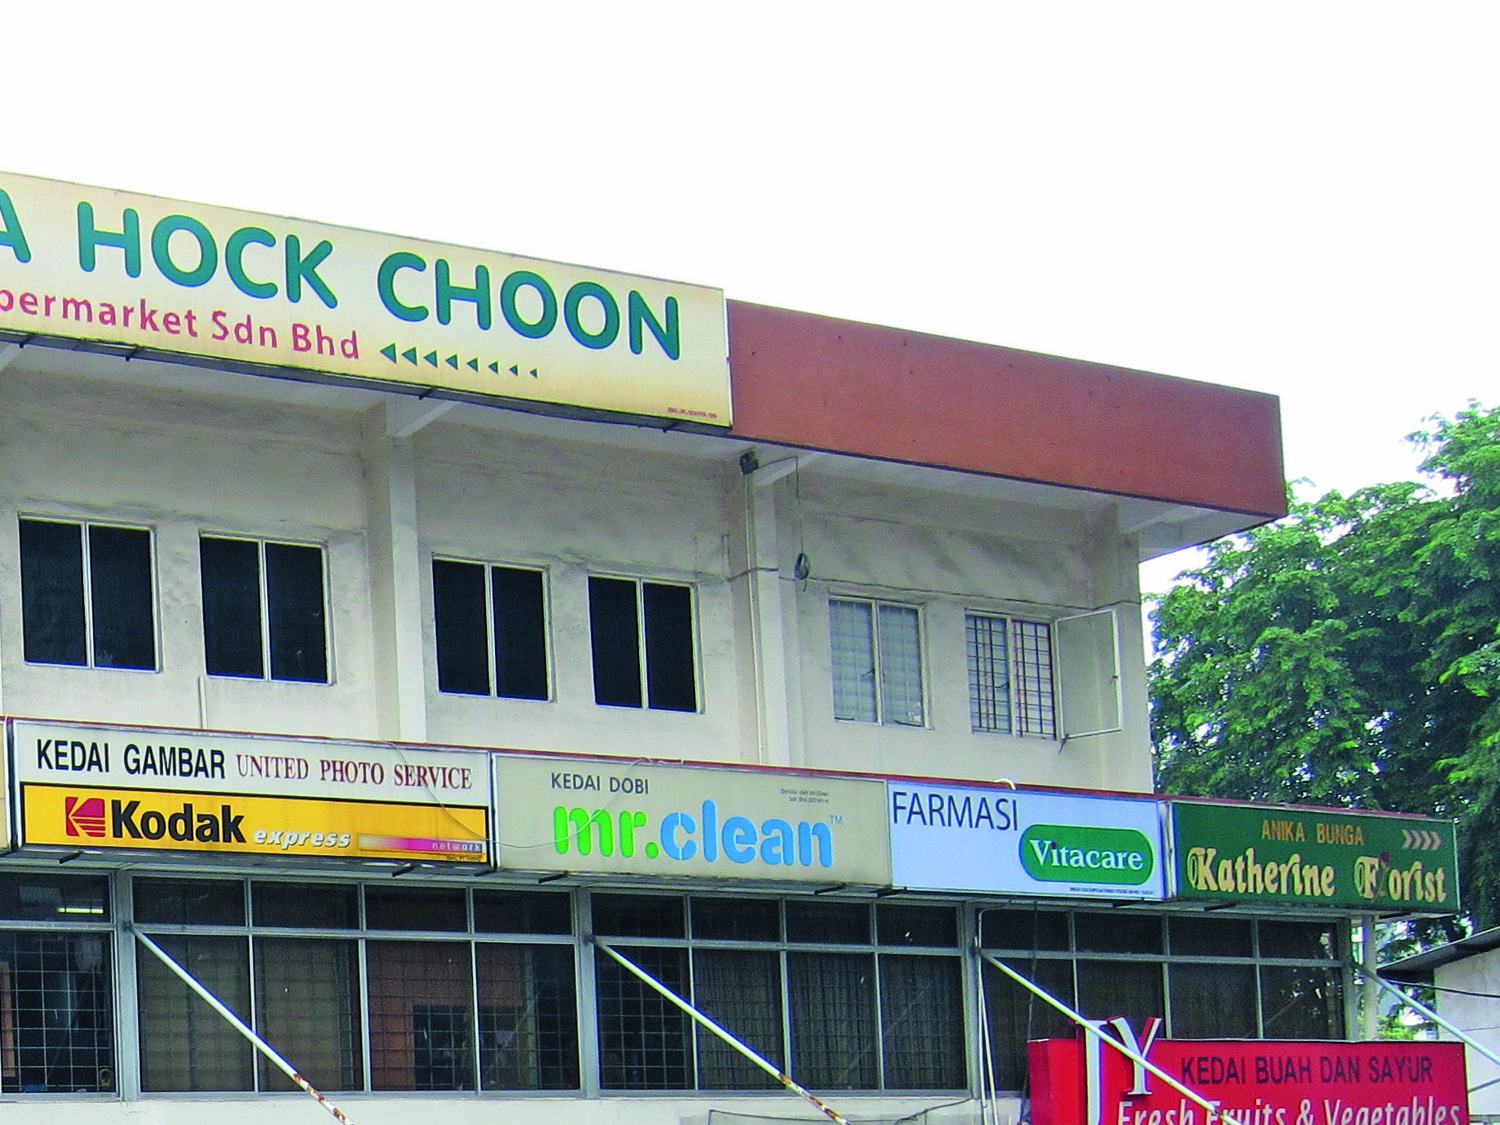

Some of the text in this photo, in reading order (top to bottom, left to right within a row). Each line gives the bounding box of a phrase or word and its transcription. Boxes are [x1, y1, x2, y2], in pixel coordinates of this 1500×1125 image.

[77, 201, 338, 308] HOCK
[377, 251, 680, 360] CHOON
[211, 310, 278, 348] Sdn
[292, 324, 360, 361] Bhd
[37, 738, 472, 789] KEDAI GAMBAR UNITED PHOTO SERVICE
[551, 772, 649, 795] KEDAI DOBI
[111, 800, 350, 849] Kodak express
[893, 791, 1018, 831] FARMASI
[432, 841, 481, 853] network
[1317, 823, 1364, 845] BUNGA
[1028, 839, 1143, 870] Vitacare
[1187, 847, 1335, 897] Katherine
[1182, 1055, 1433, 1085] KEDAI BUAH DAN SAYUR
